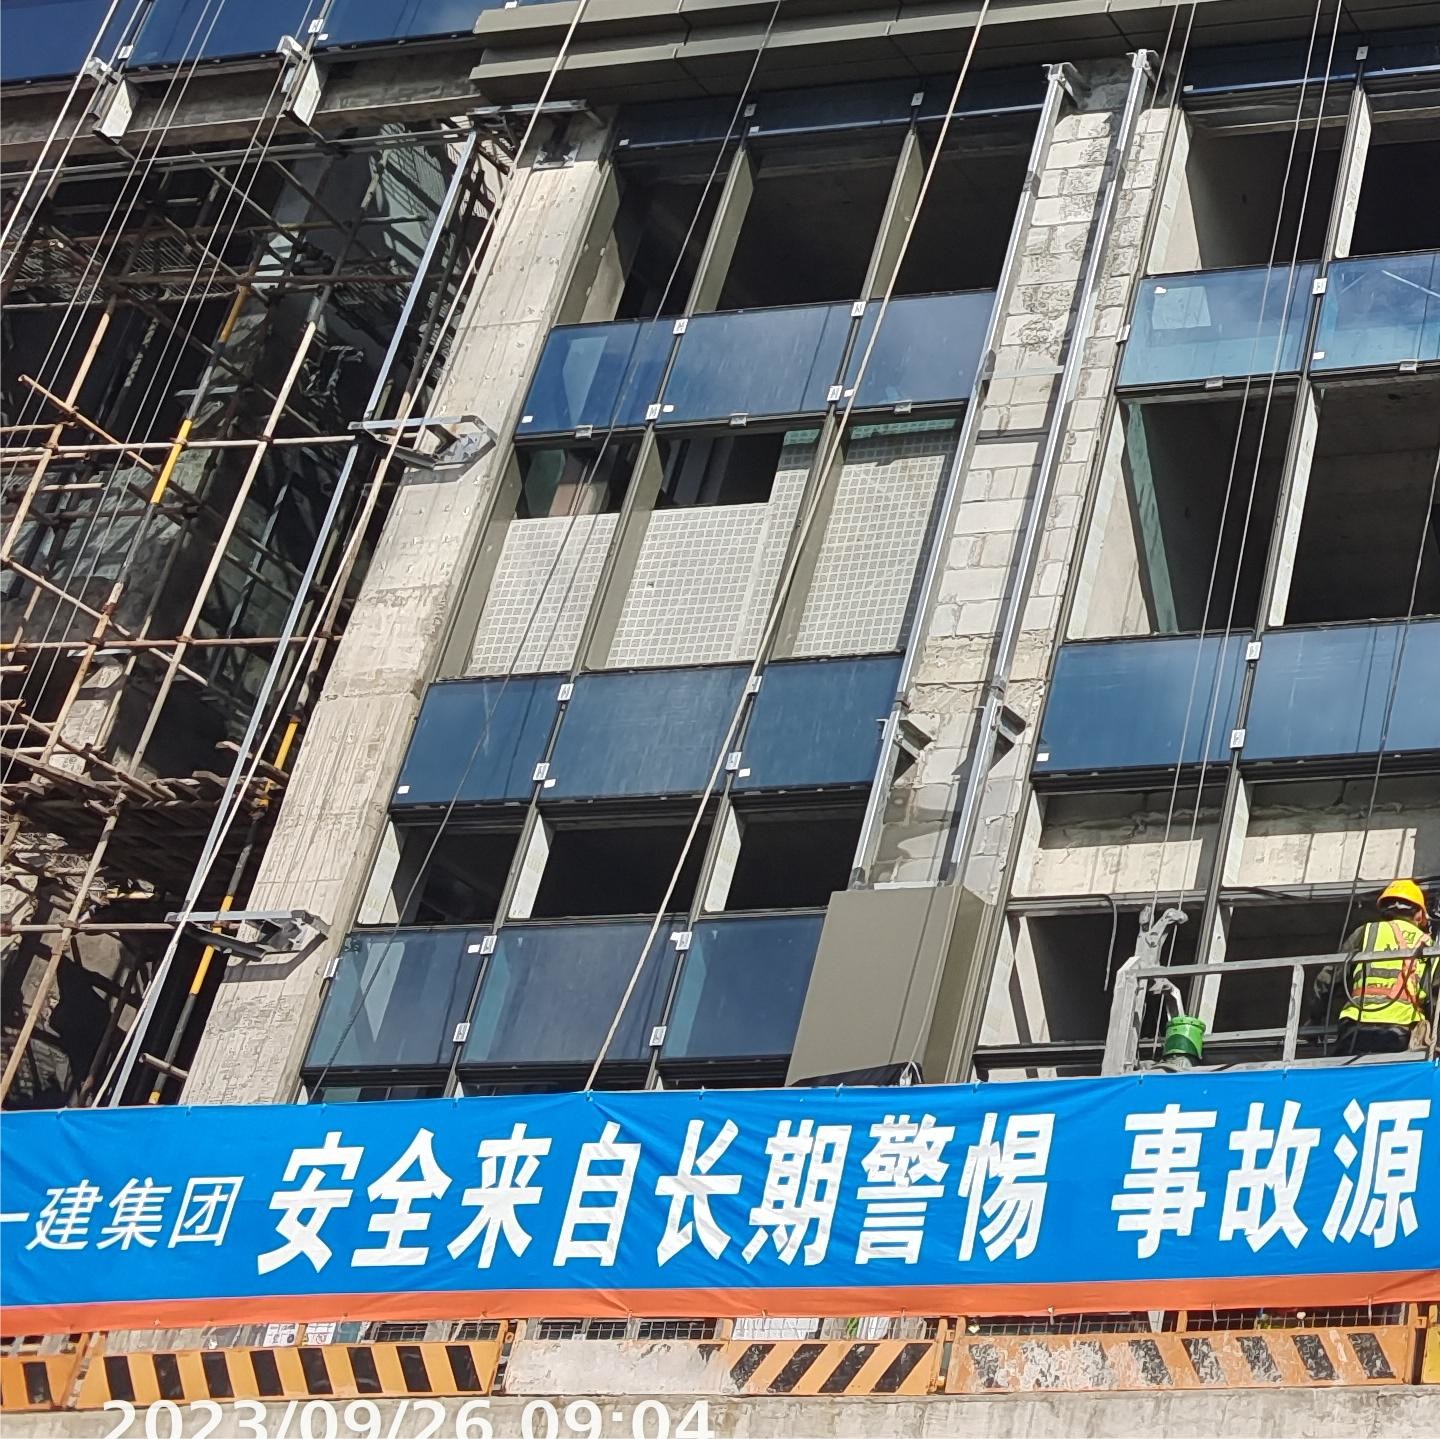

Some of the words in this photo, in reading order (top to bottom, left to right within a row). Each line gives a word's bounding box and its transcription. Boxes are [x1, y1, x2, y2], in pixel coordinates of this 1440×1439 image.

[258, 1112, 1055, 1274] 安全来自长期警惕
